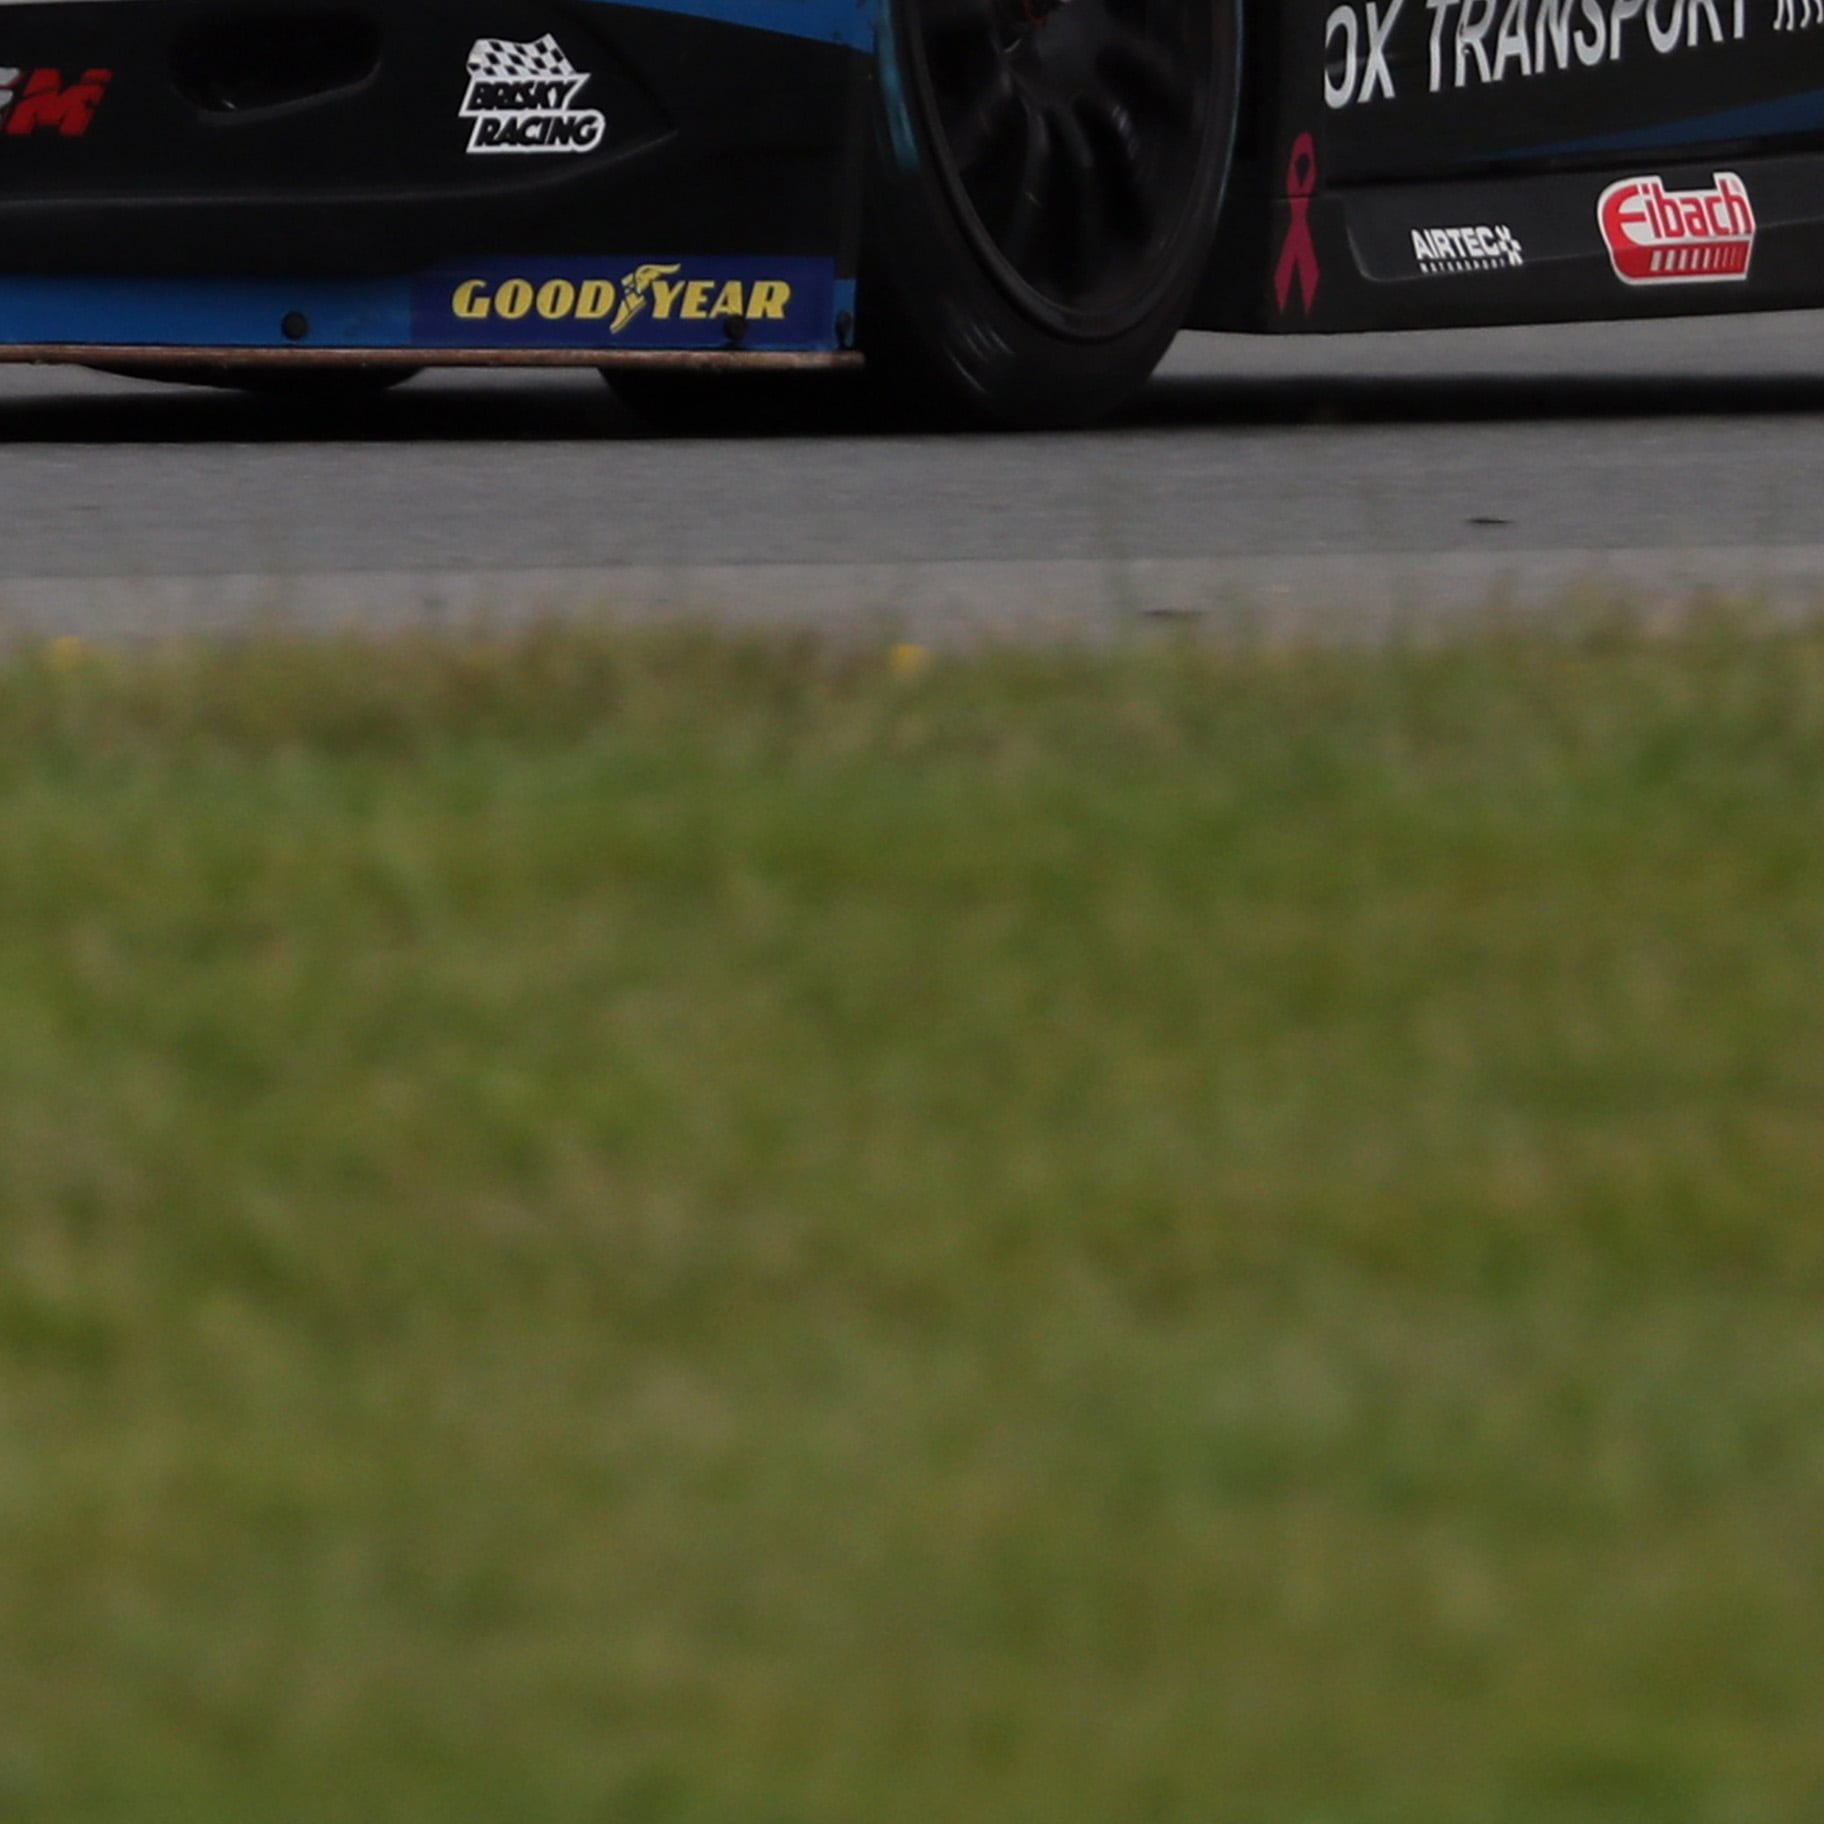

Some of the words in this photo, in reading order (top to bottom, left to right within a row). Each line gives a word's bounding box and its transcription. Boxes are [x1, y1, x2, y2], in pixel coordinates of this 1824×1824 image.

[466, 80, 577, 111] BRISKY
[474, 116, 599, 146] RACING
[1602, 178, 1753, 248] Eibach
[1411, 225, 1500, 260] AIRTEC
